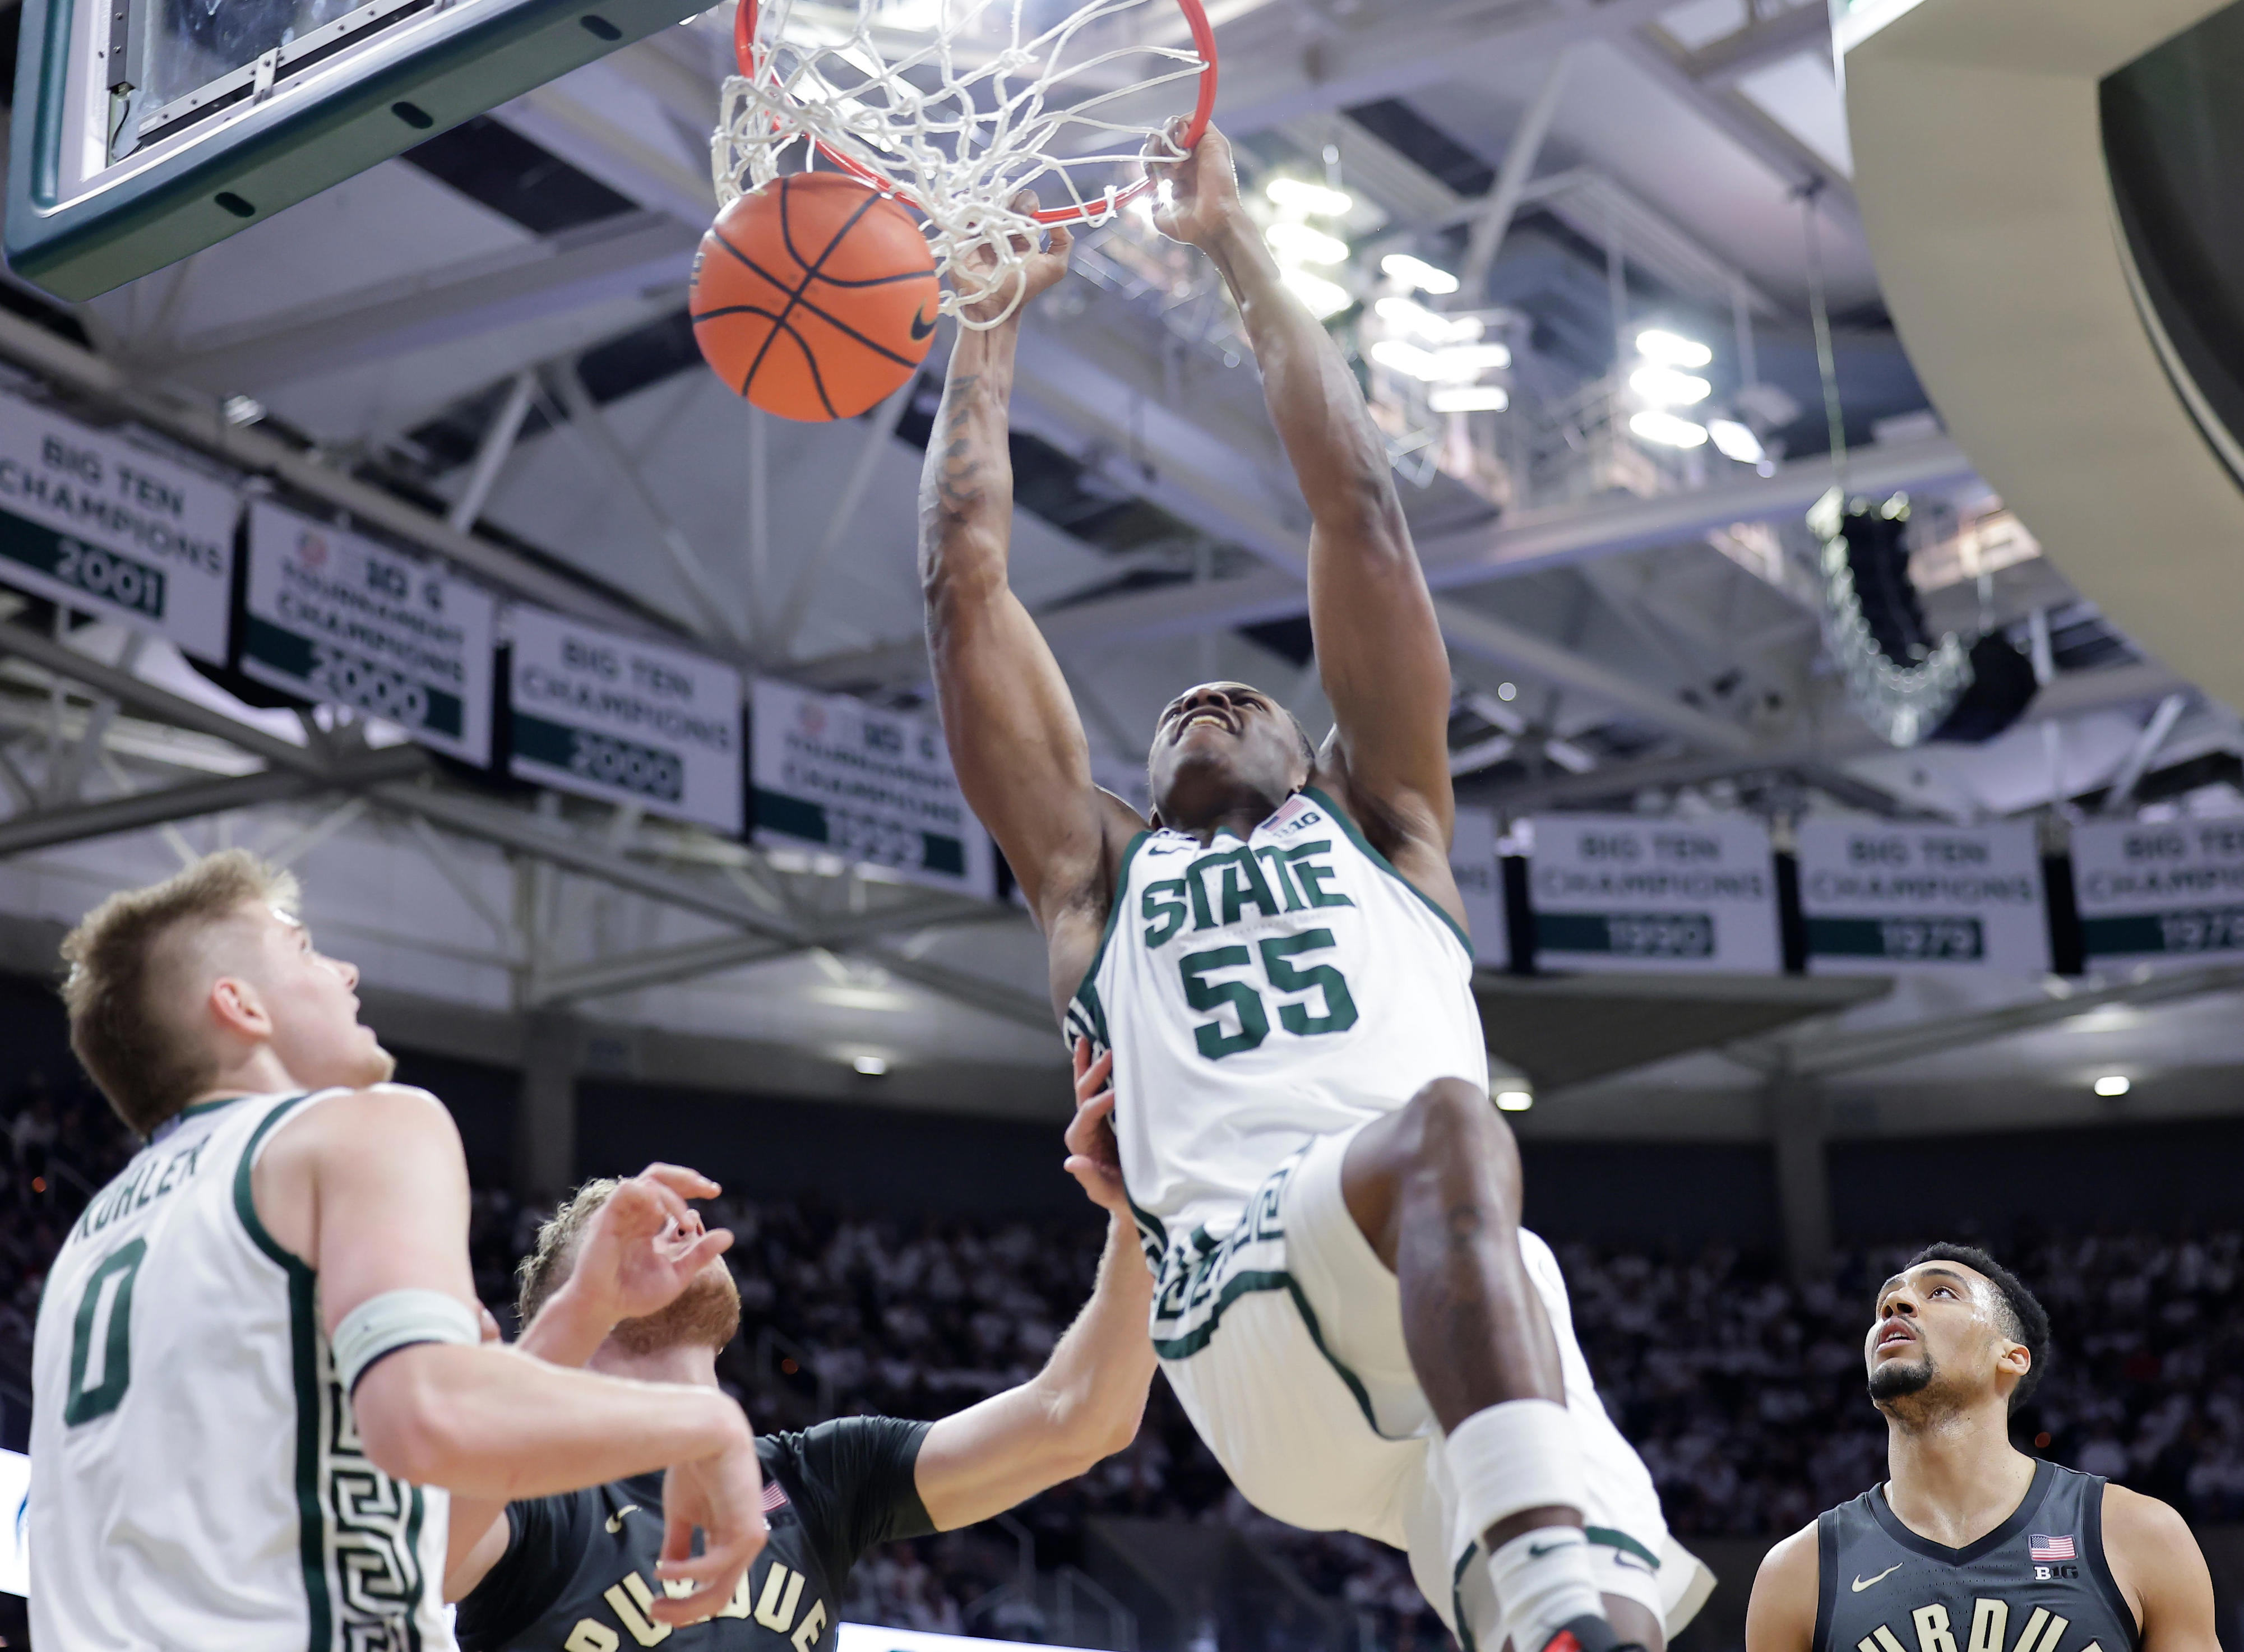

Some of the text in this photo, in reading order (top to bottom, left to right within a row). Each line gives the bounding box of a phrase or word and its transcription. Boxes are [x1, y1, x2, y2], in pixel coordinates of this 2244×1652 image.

[43, 434, 184, 518] BIG TEN
[0, 459, 223, 578] CHAMPIONS
[57, 539, 160, 610] 2001
[308, 646, 429, 728] 2000
[563, 635, 695, 700] BIG TEN
[521, 666, 729, 755] CHAMPIONS
[1579, 830, 1719, 860] BIG TEN
[1847, 835, 1988, 865] BIG TEN
[2123, 826, 2244, 860] BIG TE
[1141, 839, 1357, 949] STATE
[1812, 872, 2033, 902] CHAMPIONS
[1179, 928, 1359, 1061] 55
[64, 1235, 147, 1428] 0
